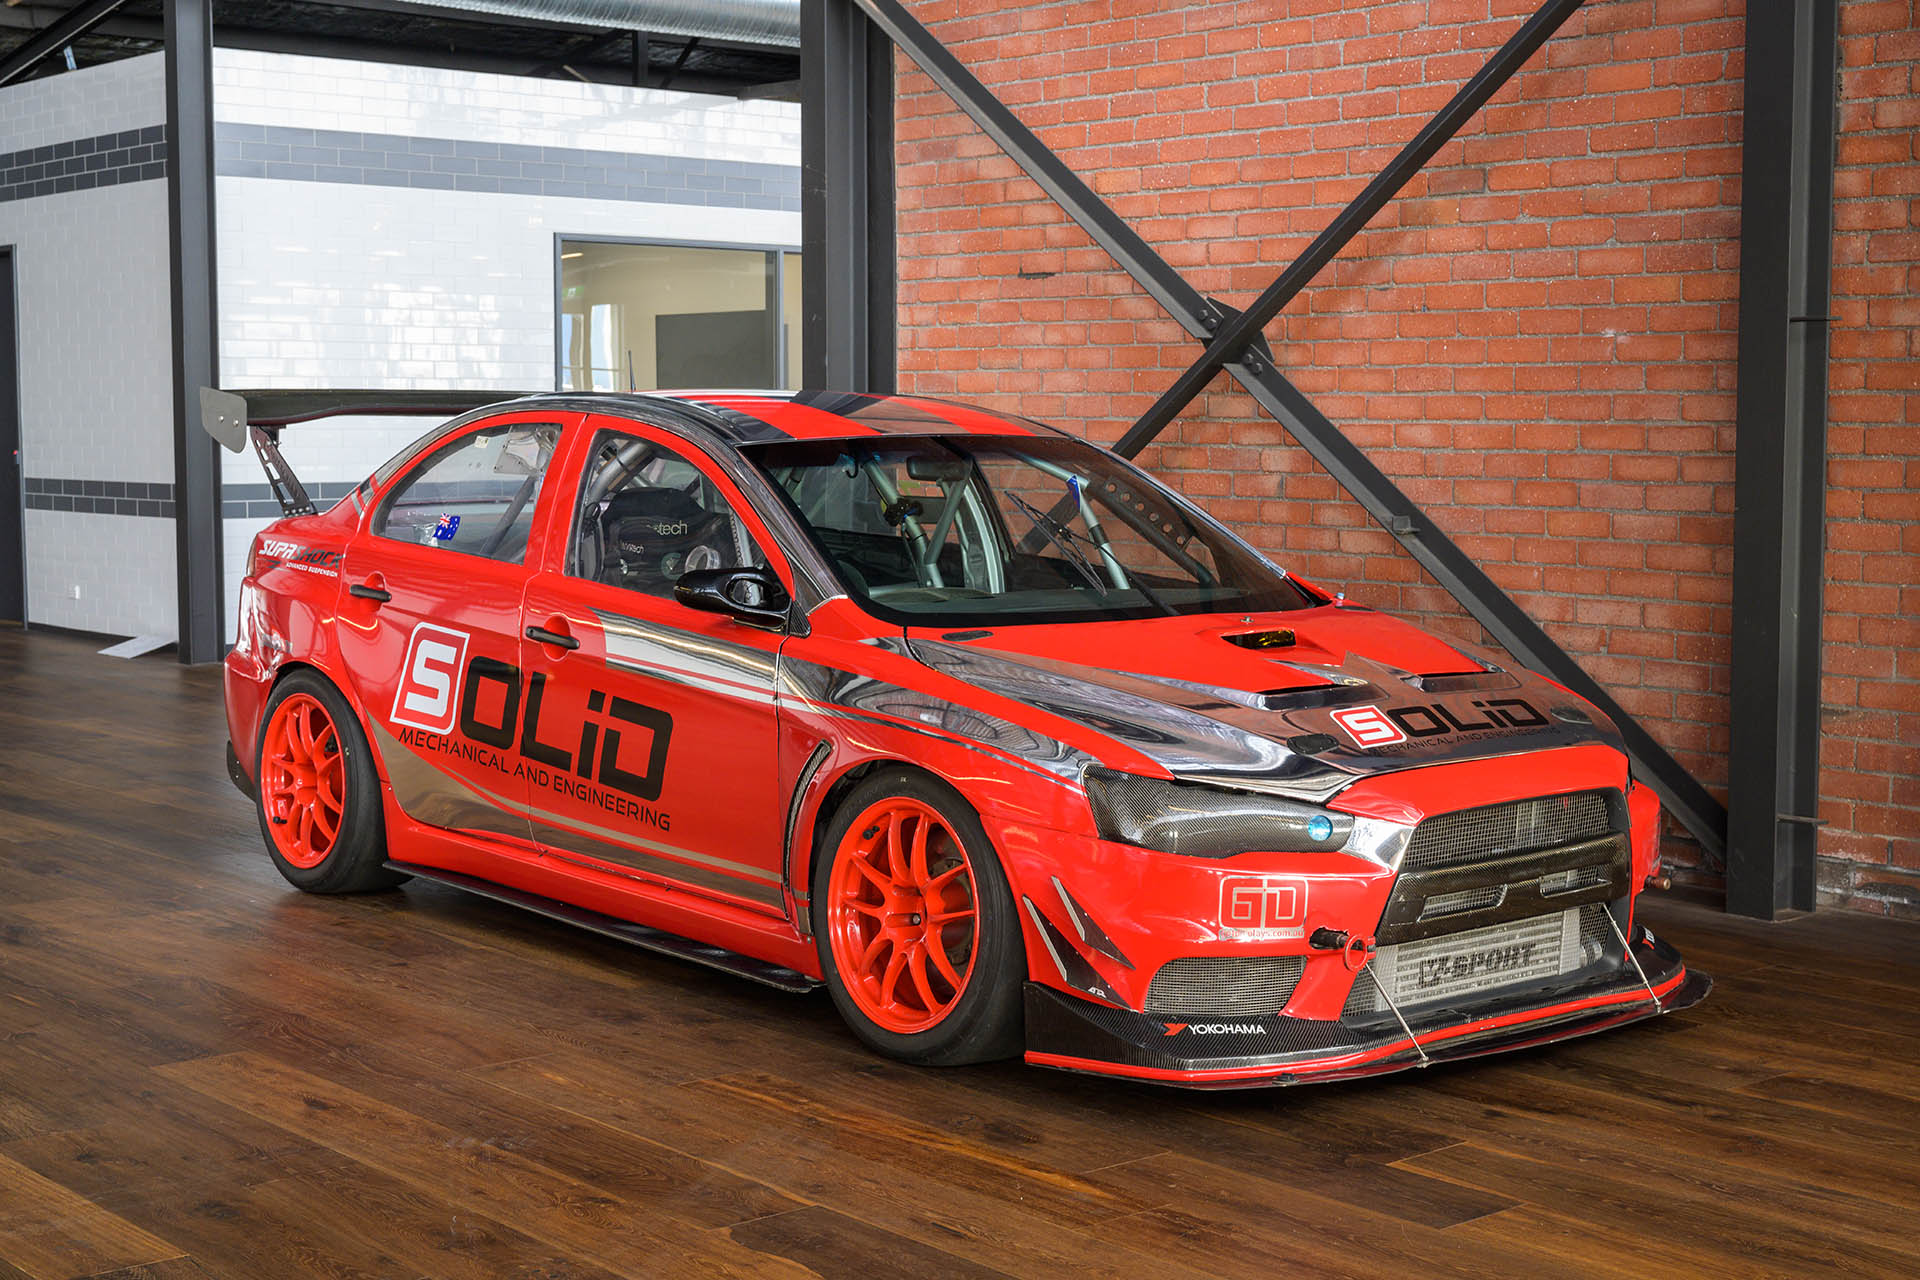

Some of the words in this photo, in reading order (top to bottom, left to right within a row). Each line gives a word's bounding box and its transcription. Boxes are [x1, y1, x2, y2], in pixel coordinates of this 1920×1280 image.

[1456, 732, 1482, 743] AND
[399, 727, 509, 774] MECHANICAL
[514, 762, 549, 787] AND
[553, 777, 671, 832] ENGINEERING
[1188, 1023, 1267, 1035] YOKOHAMA
